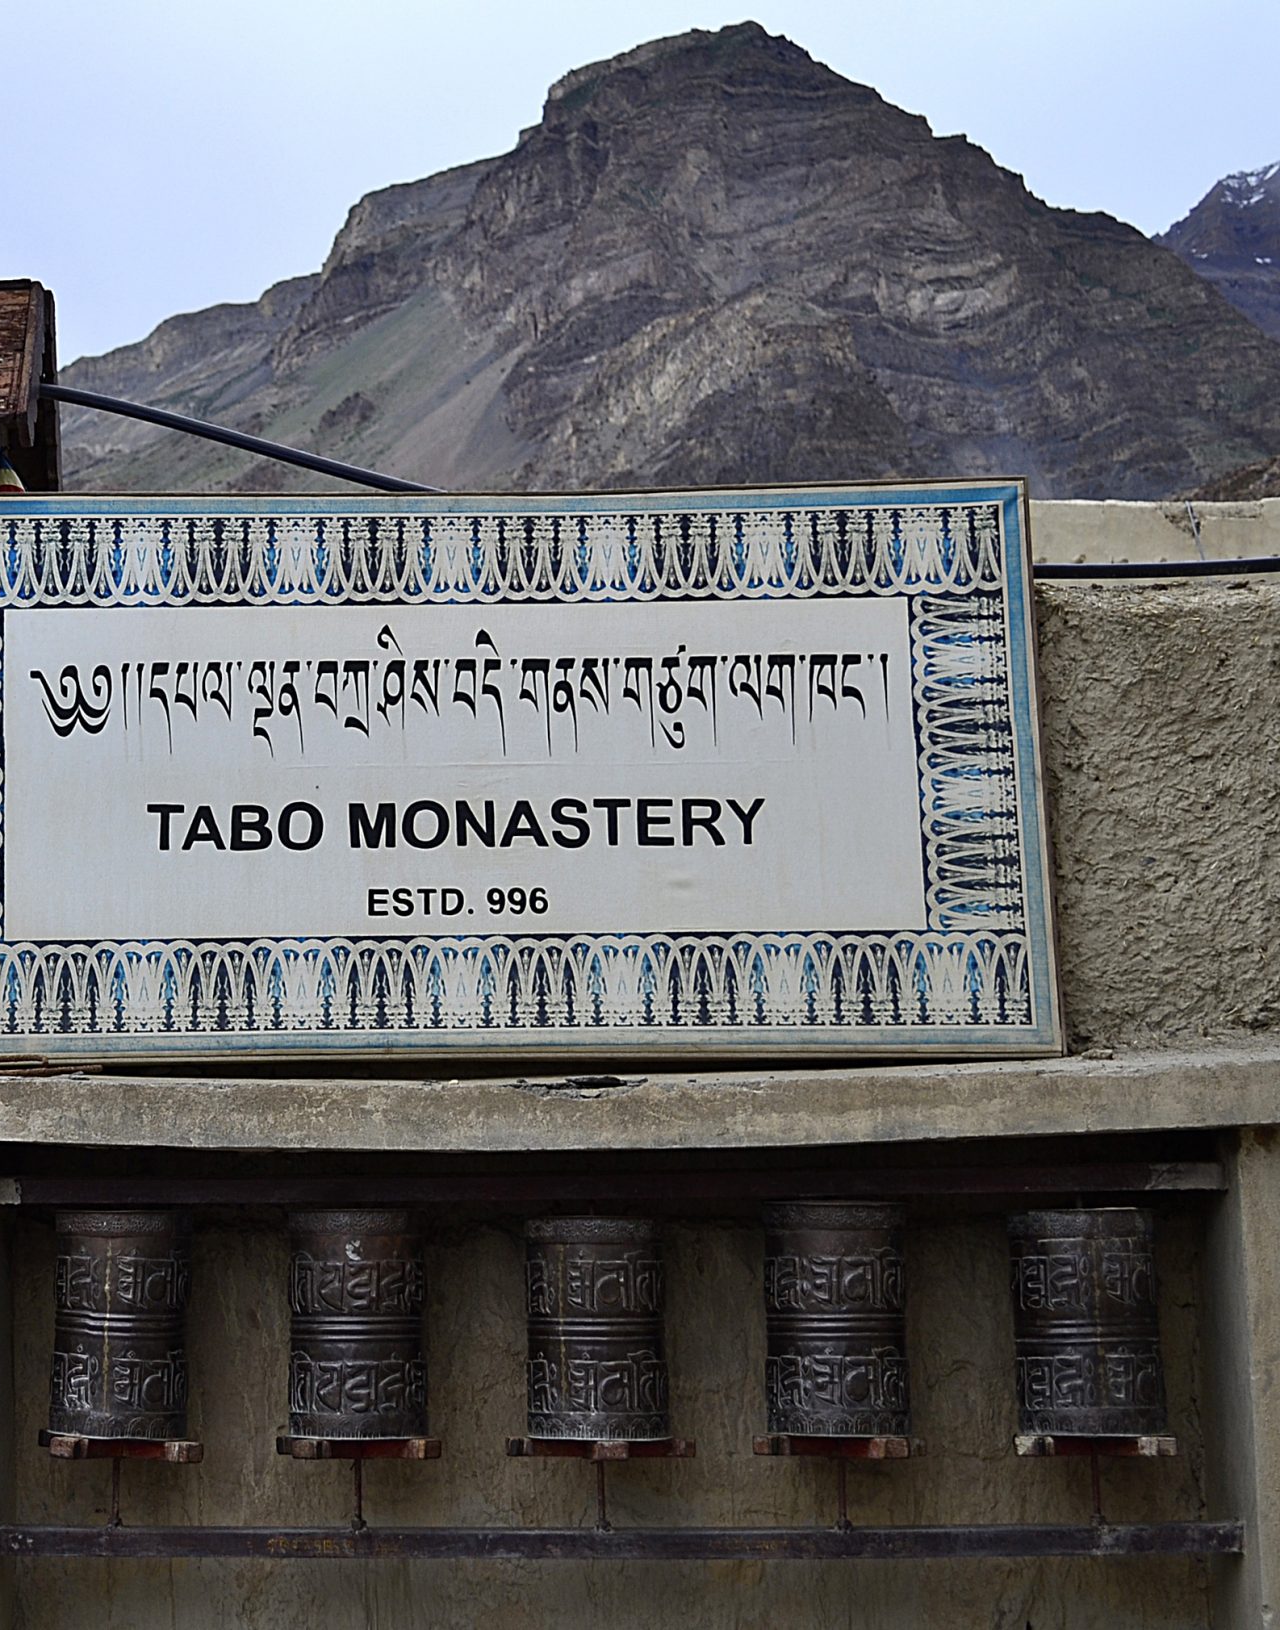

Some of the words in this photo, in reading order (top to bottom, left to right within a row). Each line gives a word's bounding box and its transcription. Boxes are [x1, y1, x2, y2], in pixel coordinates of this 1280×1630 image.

[146, 801, 324, 851] TABO
[348, 797, 766, 849] MONASTERY
[367, 888, 473, 916] ESTD.
[486, 887, 548, 915] 996
